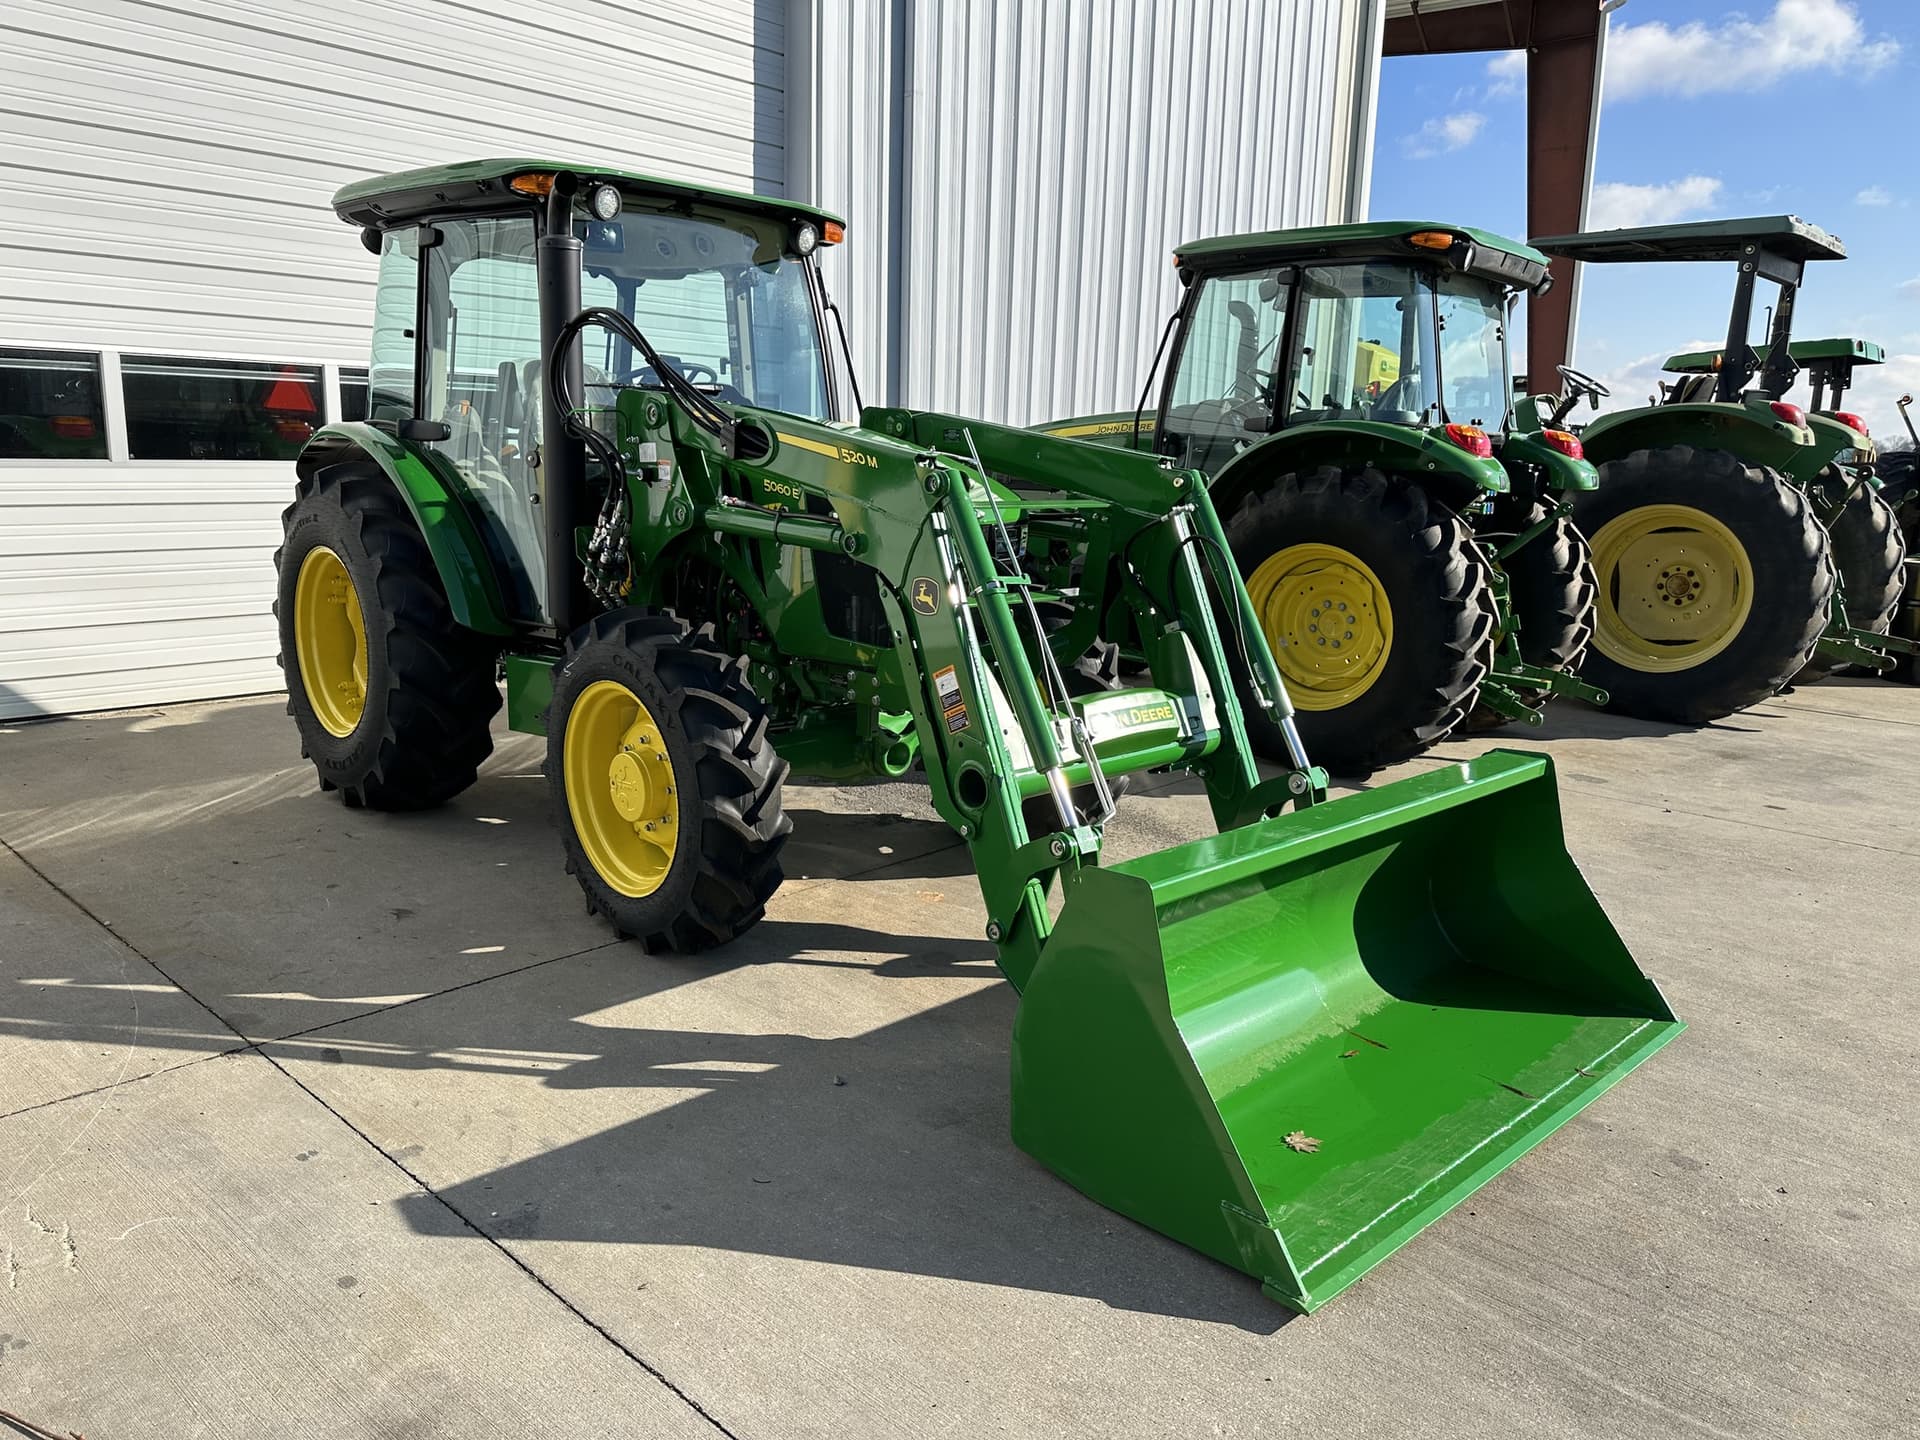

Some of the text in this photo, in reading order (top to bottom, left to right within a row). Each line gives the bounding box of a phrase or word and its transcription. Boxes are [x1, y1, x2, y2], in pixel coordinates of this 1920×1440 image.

[1096, 423, 1153, 434] JOHN DERE
[840, 447, 879, 469] 520 M
[763, 478, 800, 500] 5060 E
[1130, 706, 1174, 724] DEERE
